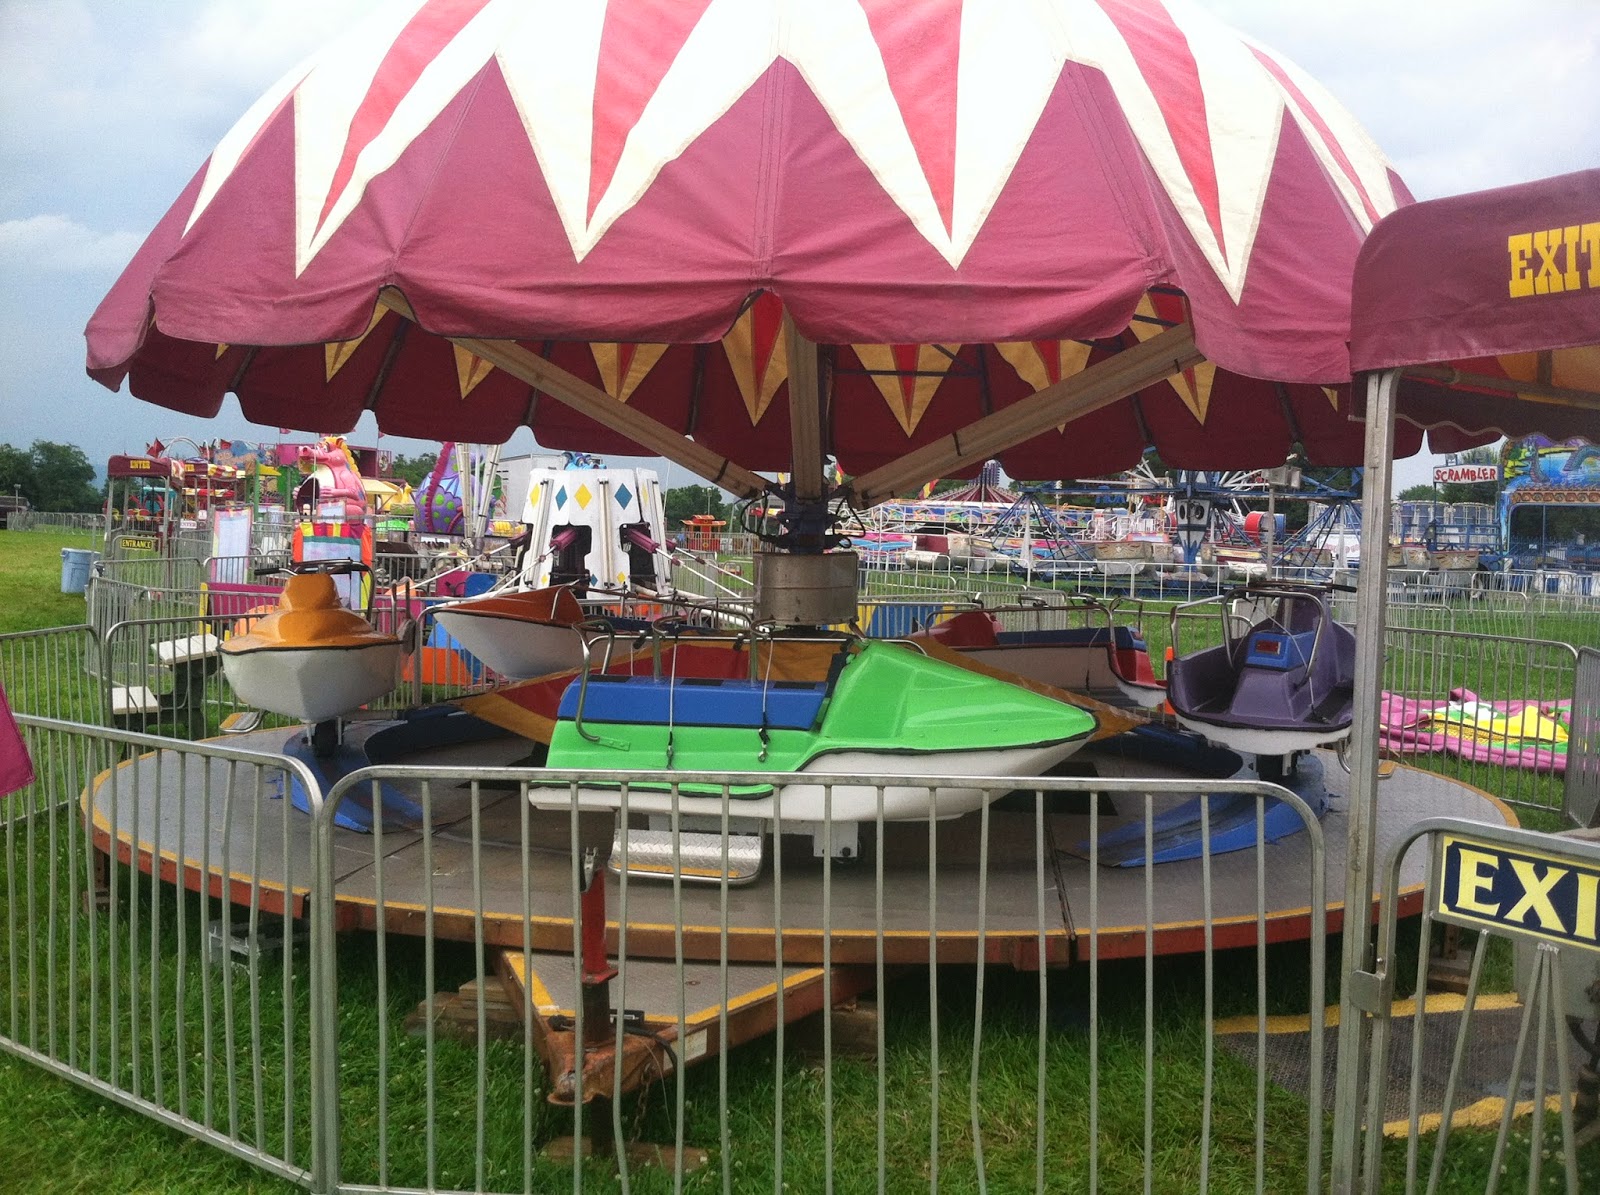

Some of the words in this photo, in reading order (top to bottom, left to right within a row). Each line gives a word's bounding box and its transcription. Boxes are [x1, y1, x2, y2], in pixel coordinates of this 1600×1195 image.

[1508, 221, 1600, 298] EXIT
[1434, 467, 1496, 482] SCRAMBLER
[122, 539, 151, 549] ENTRANCE
